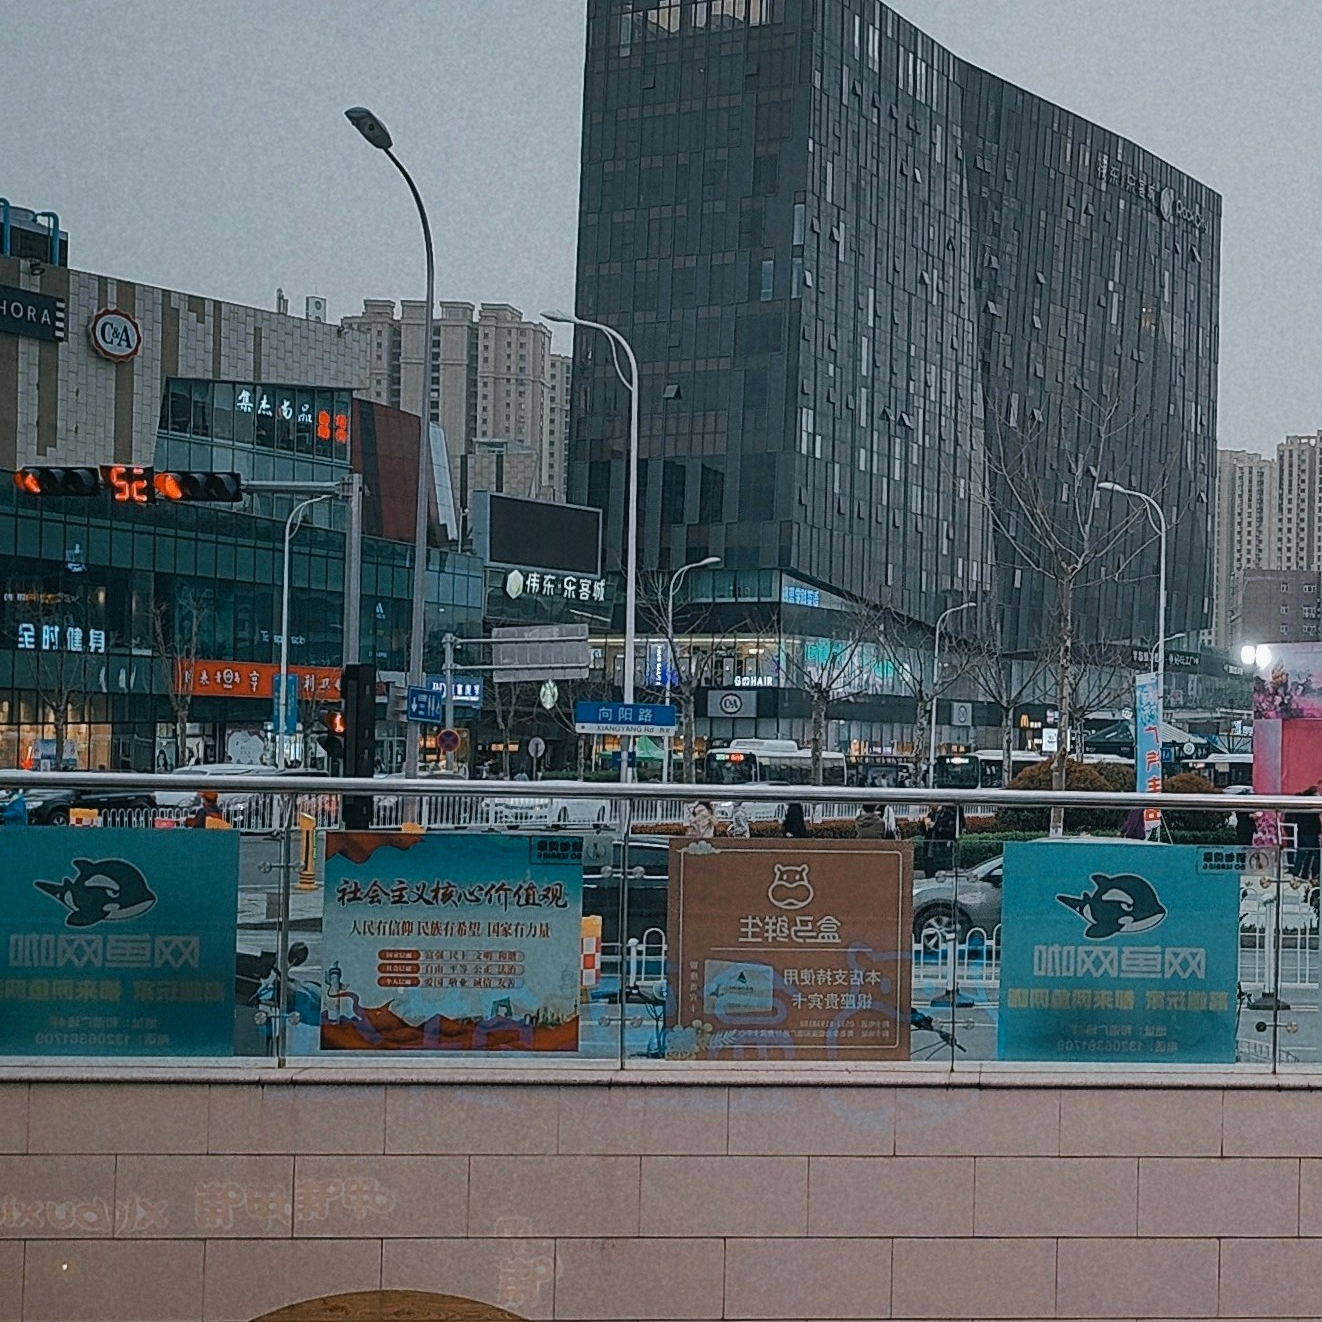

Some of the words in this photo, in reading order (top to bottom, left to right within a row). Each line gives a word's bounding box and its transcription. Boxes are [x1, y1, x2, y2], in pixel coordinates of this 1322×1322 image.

[99, 320, 133, 350] C&A
[598, 707, 652, 723] 向阳路
[336, 878, 569, 913] 社会主义核心价值观
[350, 919, 414, 937] 人民有信仰
[417, 920, 481, 938] 民族有希望
[487, 921, 551, 939] 国家有力量
